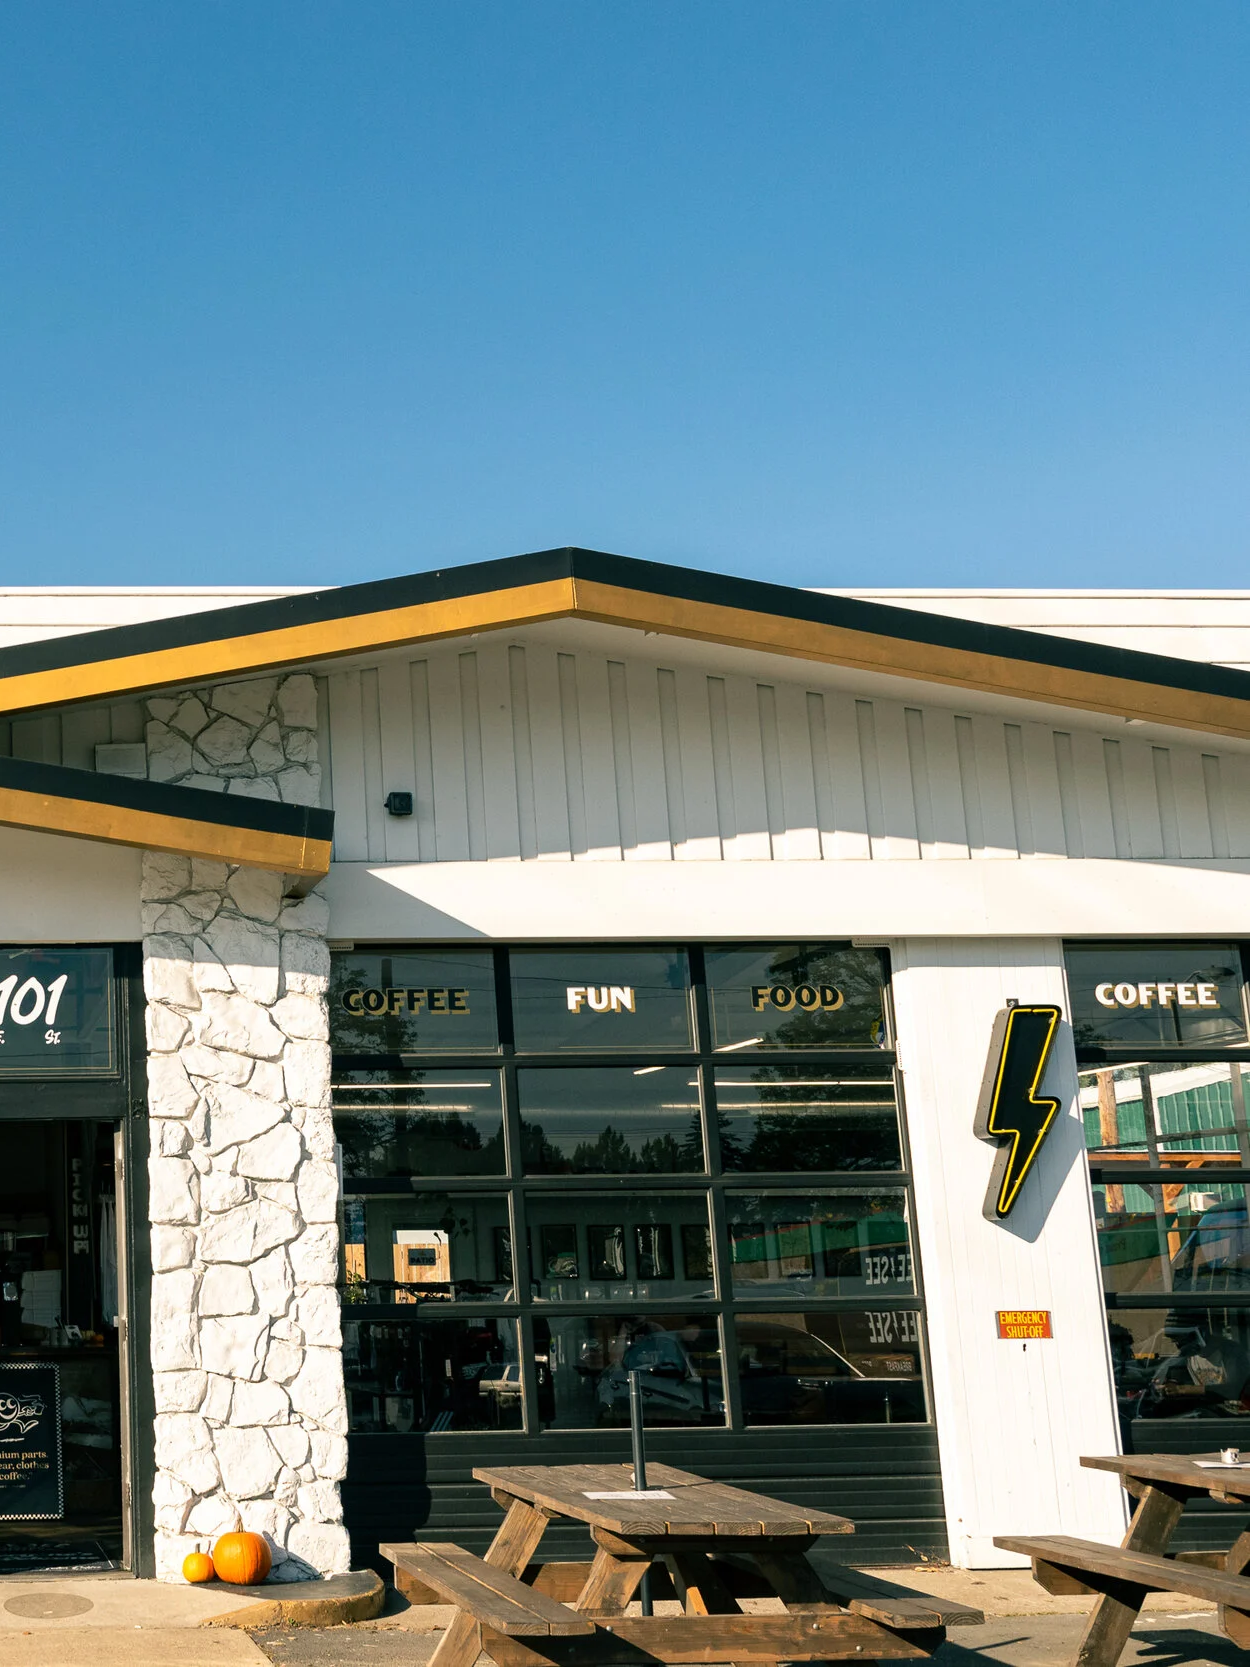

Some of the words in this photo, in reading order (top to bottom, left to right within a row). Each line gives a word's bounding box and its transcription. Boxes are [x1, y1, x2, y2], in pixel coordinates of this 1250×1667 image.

[341, 987, 470, 1016] COFFEE
[566, 985, 636, 1013] FUN
[751, 984, 844, 1012] FOOD
[1095, 982, 1221, 1009] COFFEE
[999, 1311, 1047, 1324] EMERGENCY
[1006, 1325, 1044, 1338] SHUT-OFF
